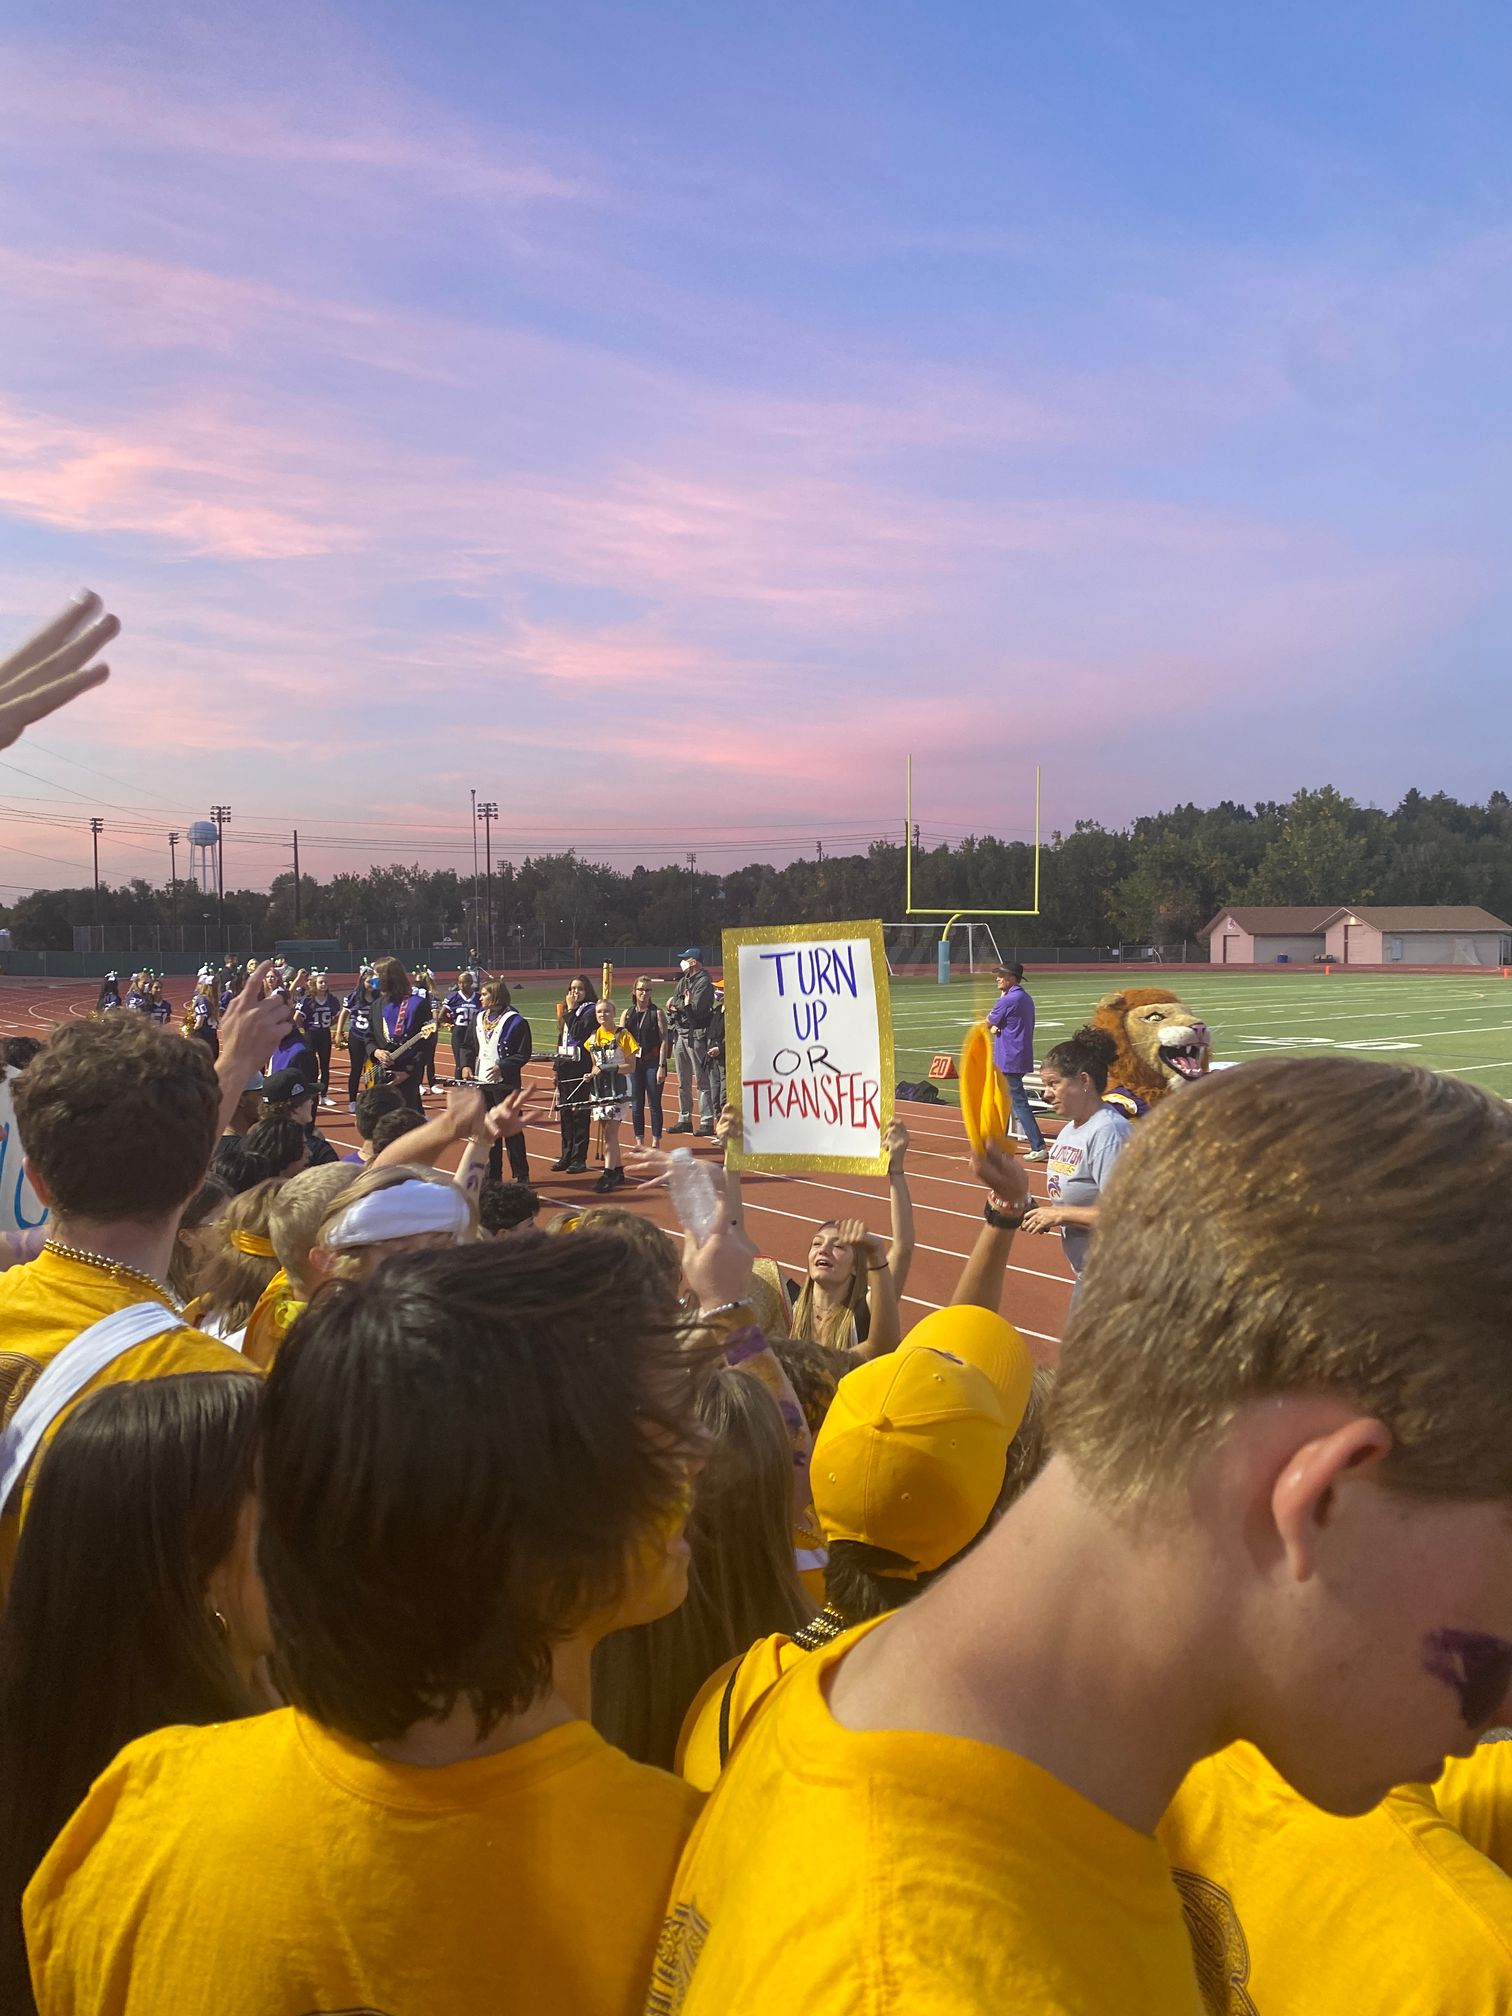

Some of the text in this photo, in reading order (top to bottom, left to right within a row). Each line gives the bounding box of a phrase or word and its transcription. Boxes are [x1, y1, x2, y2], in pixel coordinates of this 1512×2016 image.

[759, 945, 858, 998] TURN
[792, 999, 828, 1042] UP
[772, 1045, 841, 1076] OR
[930, 1058, 948, 1076] 20
[742, 1072, 881, 1130] TRANSFER
